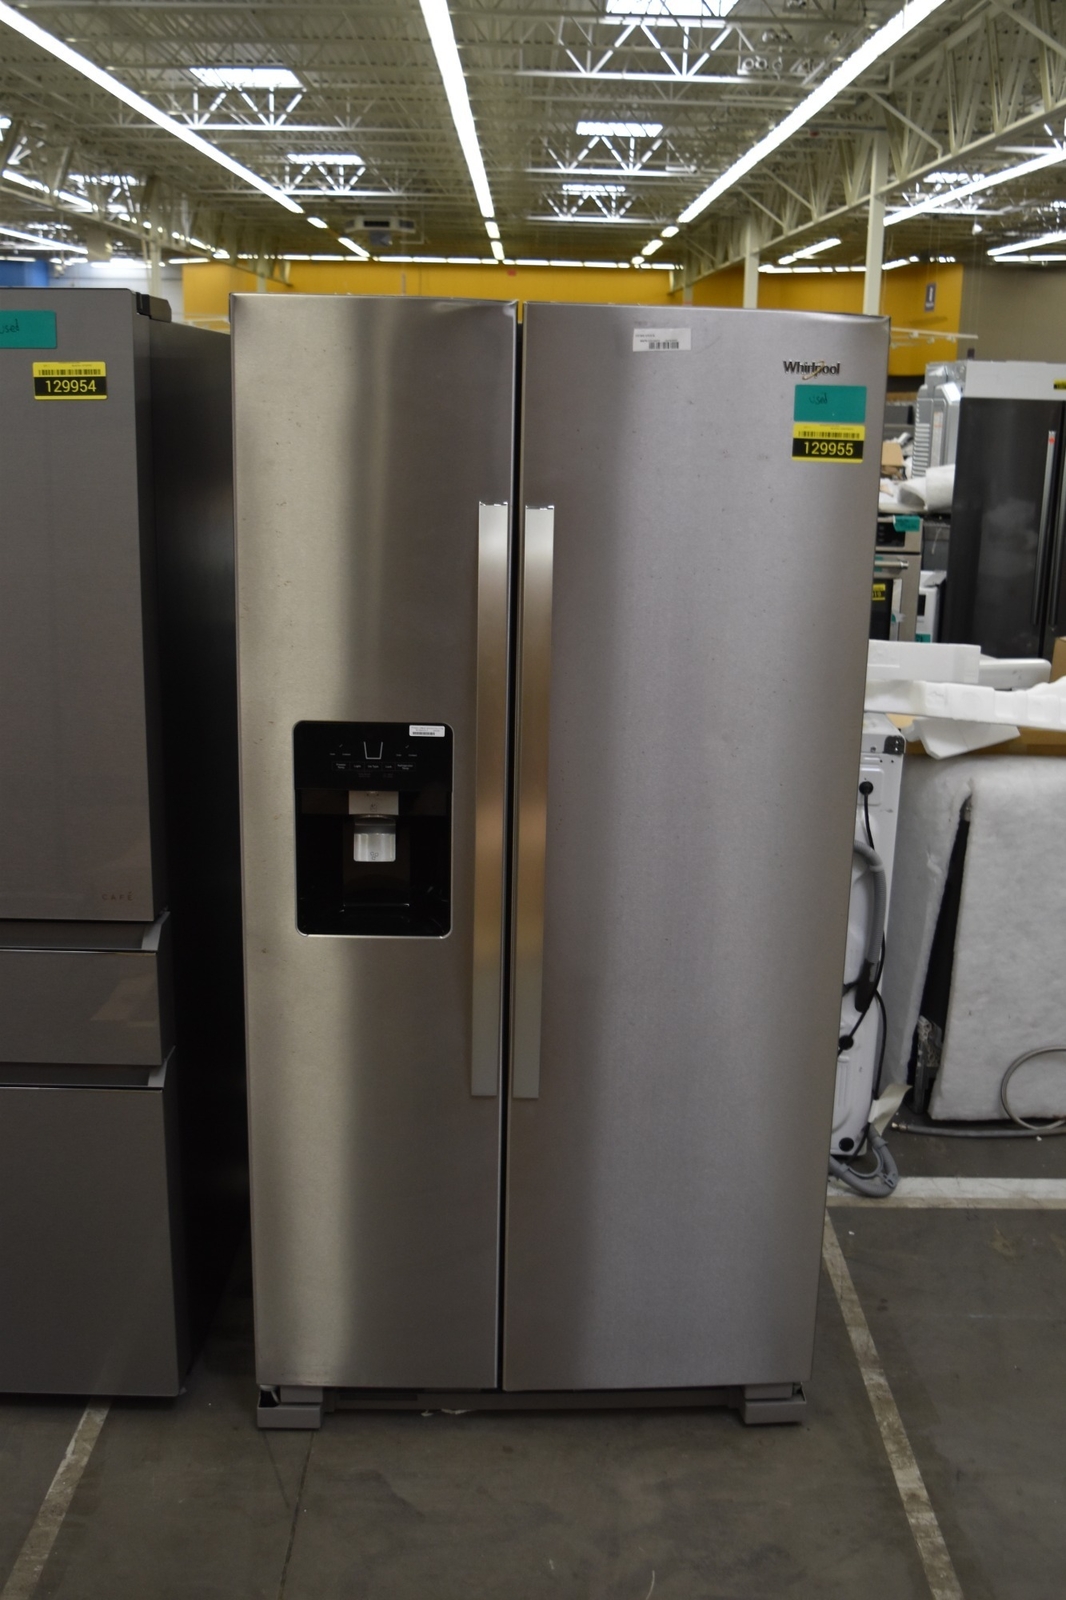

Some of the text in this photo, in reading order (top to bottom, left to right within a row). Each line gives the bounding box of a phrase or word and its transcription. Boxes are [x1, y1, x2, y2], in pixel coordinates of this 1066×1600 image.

[783, 360, 841, 379] Whirlpool
[45, 379, 97, 393] 129954
[804, 441, 854, 456] 129955
[101, 891, 133, 901] CAFÉ
